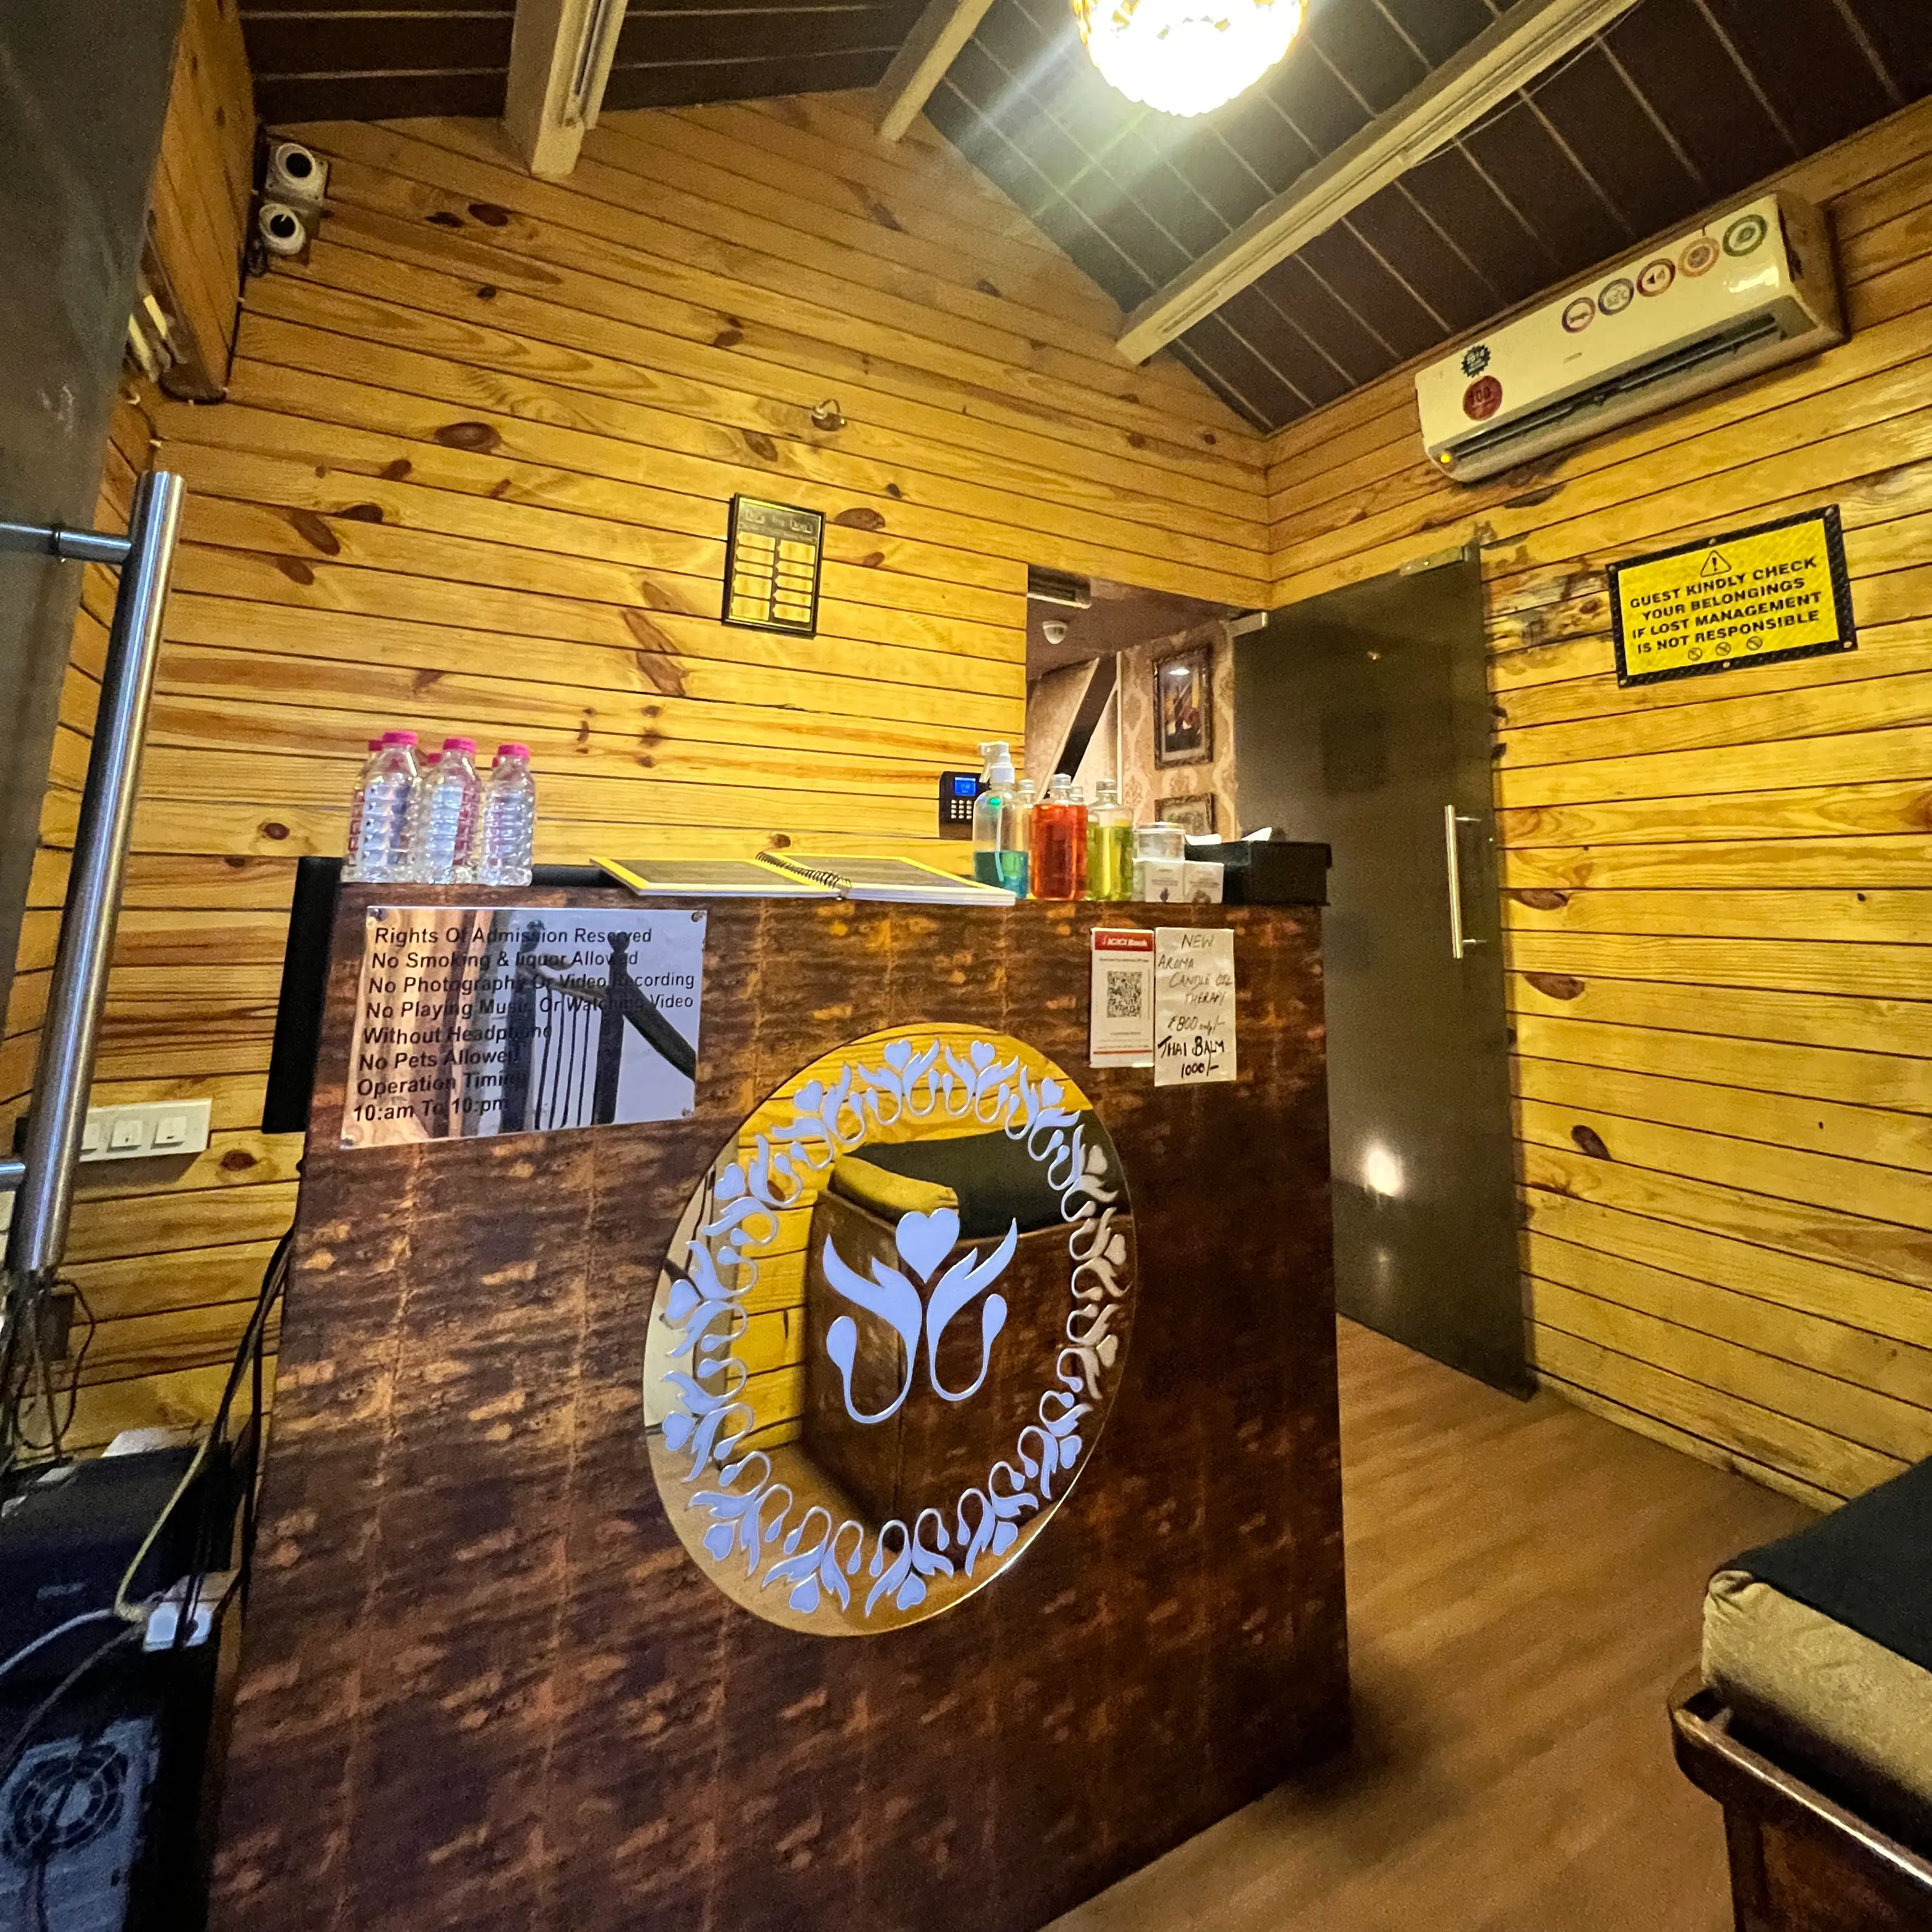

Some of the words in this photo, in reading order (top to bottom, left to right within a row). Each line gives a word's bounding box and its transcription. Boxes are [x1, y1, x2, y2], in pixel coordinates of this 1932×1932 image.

[1630, 588, 1681, 609] GUEST
[1686, 573, 1745, 596] KINDLY
[1753, 557, 1817, 581] CHECK
[1641, 604, 1685, 622] YOUR
[1690, 578, 1805, 611] BELONGINGS
[1632, 627, 1646, 640] IF
[1650, 618, 1690, 636] LOST
[1695, 592, 1821, 627] MANAGEMENT
[1637, 641, 1652, 654] IS
[1657, 636, 1690, 650] NOT
[1695, 610, 1820, 643] RESPONSIBLE
[375, 928, 438, 947] Rights
[446, 928, 468, 943] Of
[473, 928, 567, 943] Admission
[575, 928, 652, 942] Reserved
[1181, 933, 1214, 949] NEW
[372, 953, 399, 969] No
[406, 952, 491, 970] Smoking
[497, 951, 509, 967] &
[1158, 954, 1194, 969] AROMA
[369, 977, 395, 994] No
[560, 974, 606, 989] Video
[367, 1002, 393, 1019] No
[401, 1001, 473, 1020] Playing
[540, 997, 562, 1013] Or
[650, 993, 694, 1008] Video
[364, 1027, 440, 1044] Without
[1157, 1035, 1187, 1059] THAI
[1192, 1036, 1225, 1055] BALM
[359, 1054, 388, 1071] No
[395, 1052, 438, 1069] Pets
[1181, 1057, 1219, 1078] 1000/-
[357, 1074, 456, 1100] Operation
[353, 1104, 415, 1122] 10:am
[423, 1100, 447, 1116] To
[452, 1097, 511, 1116] 10:pm
